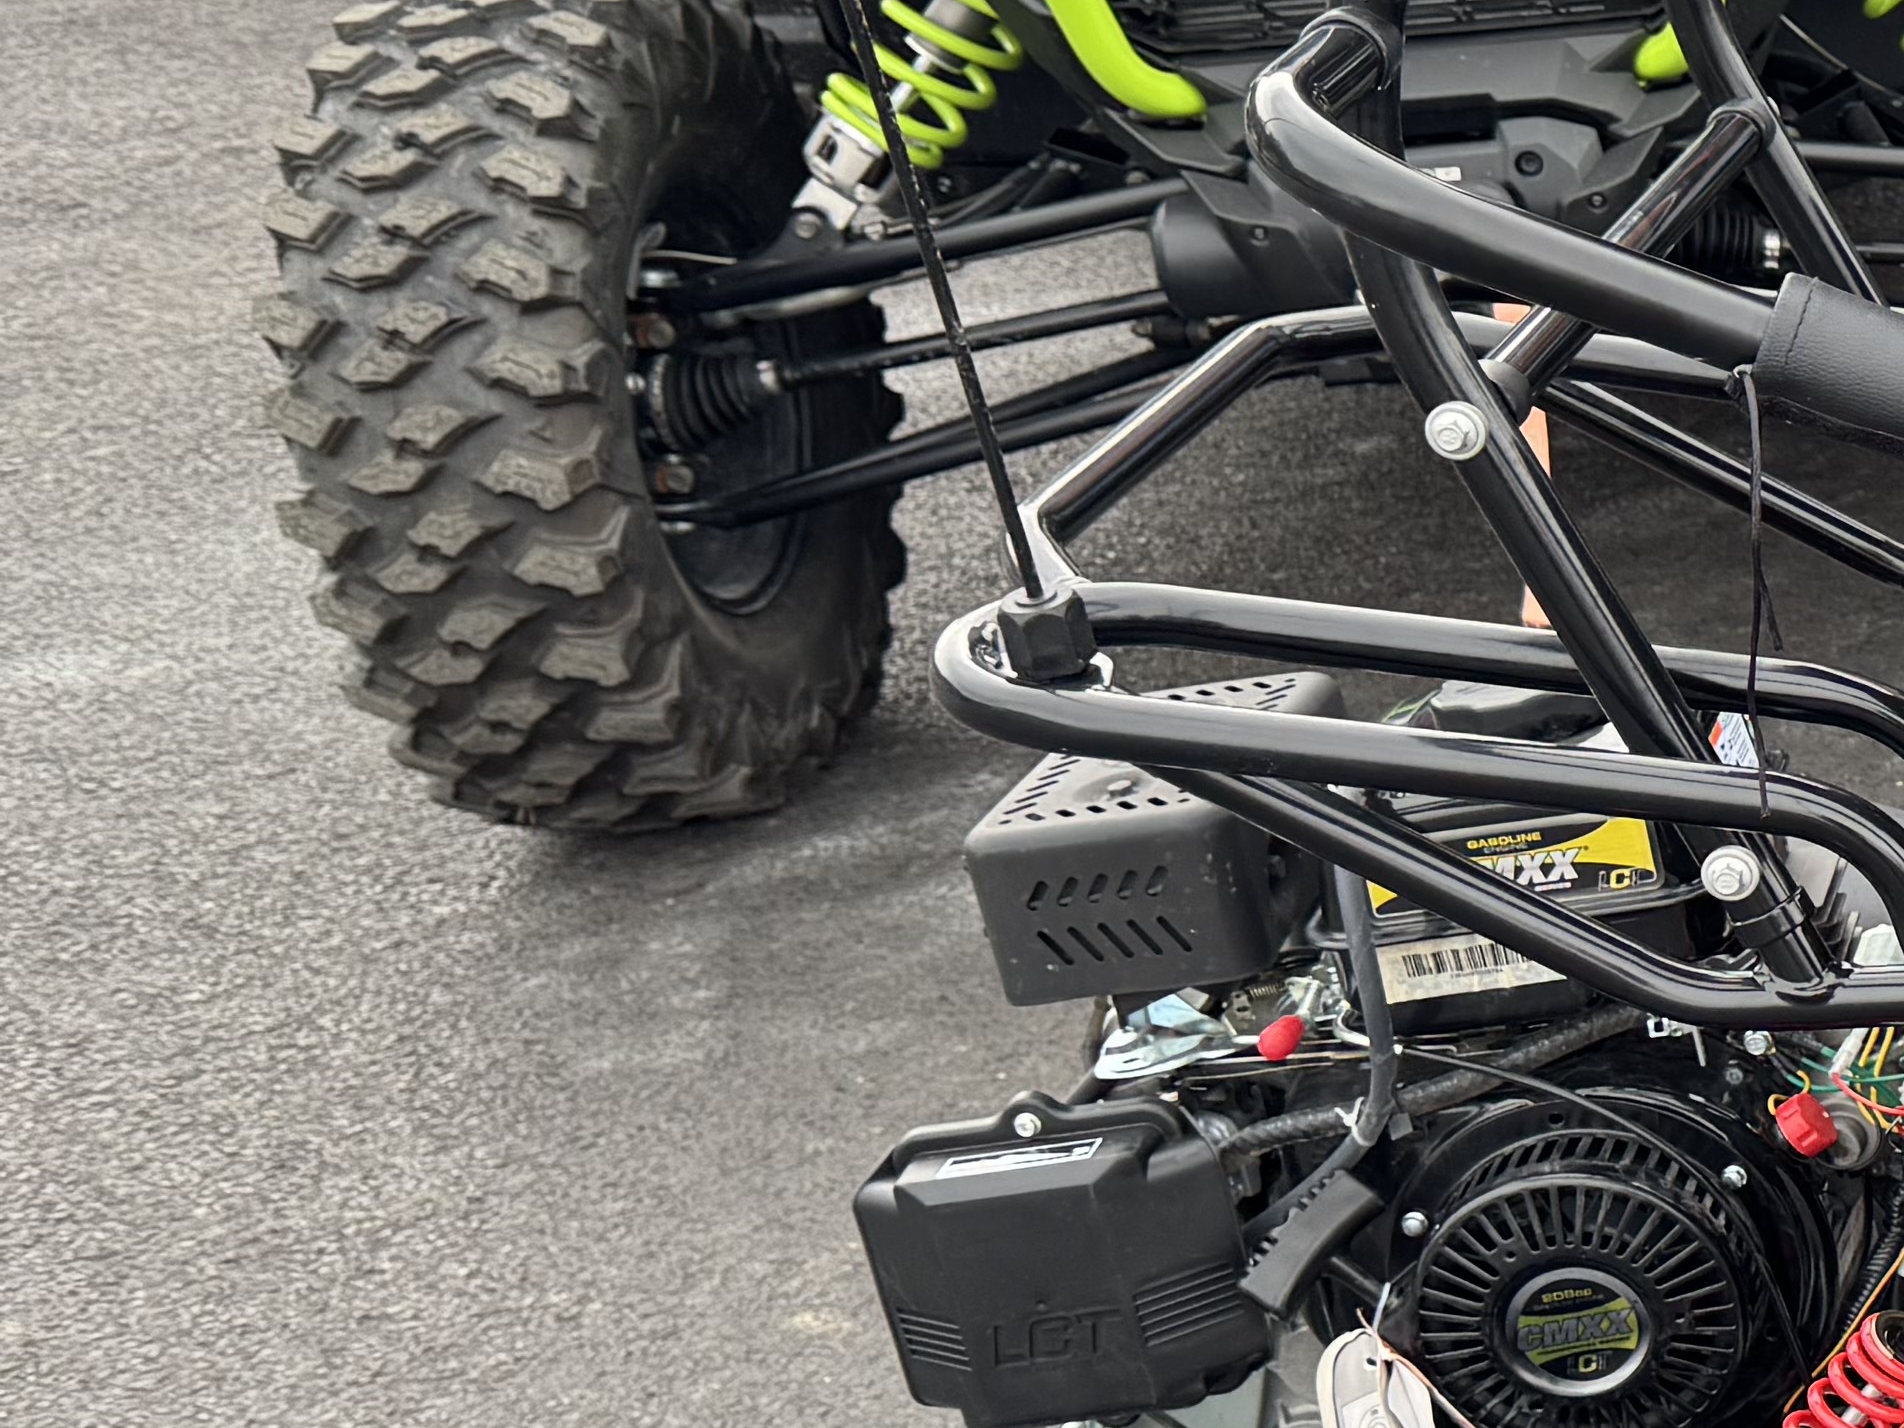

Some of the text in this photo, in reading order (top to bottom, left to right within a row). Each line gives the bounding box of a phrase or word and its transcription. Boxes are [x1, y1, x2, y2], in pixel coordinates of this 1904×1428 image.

[1467, 831, 1542, 850] GASOLINE
[1470, 846, 1584, 886] MXX
[1517, 1309, 1634, 1352] CMXX
